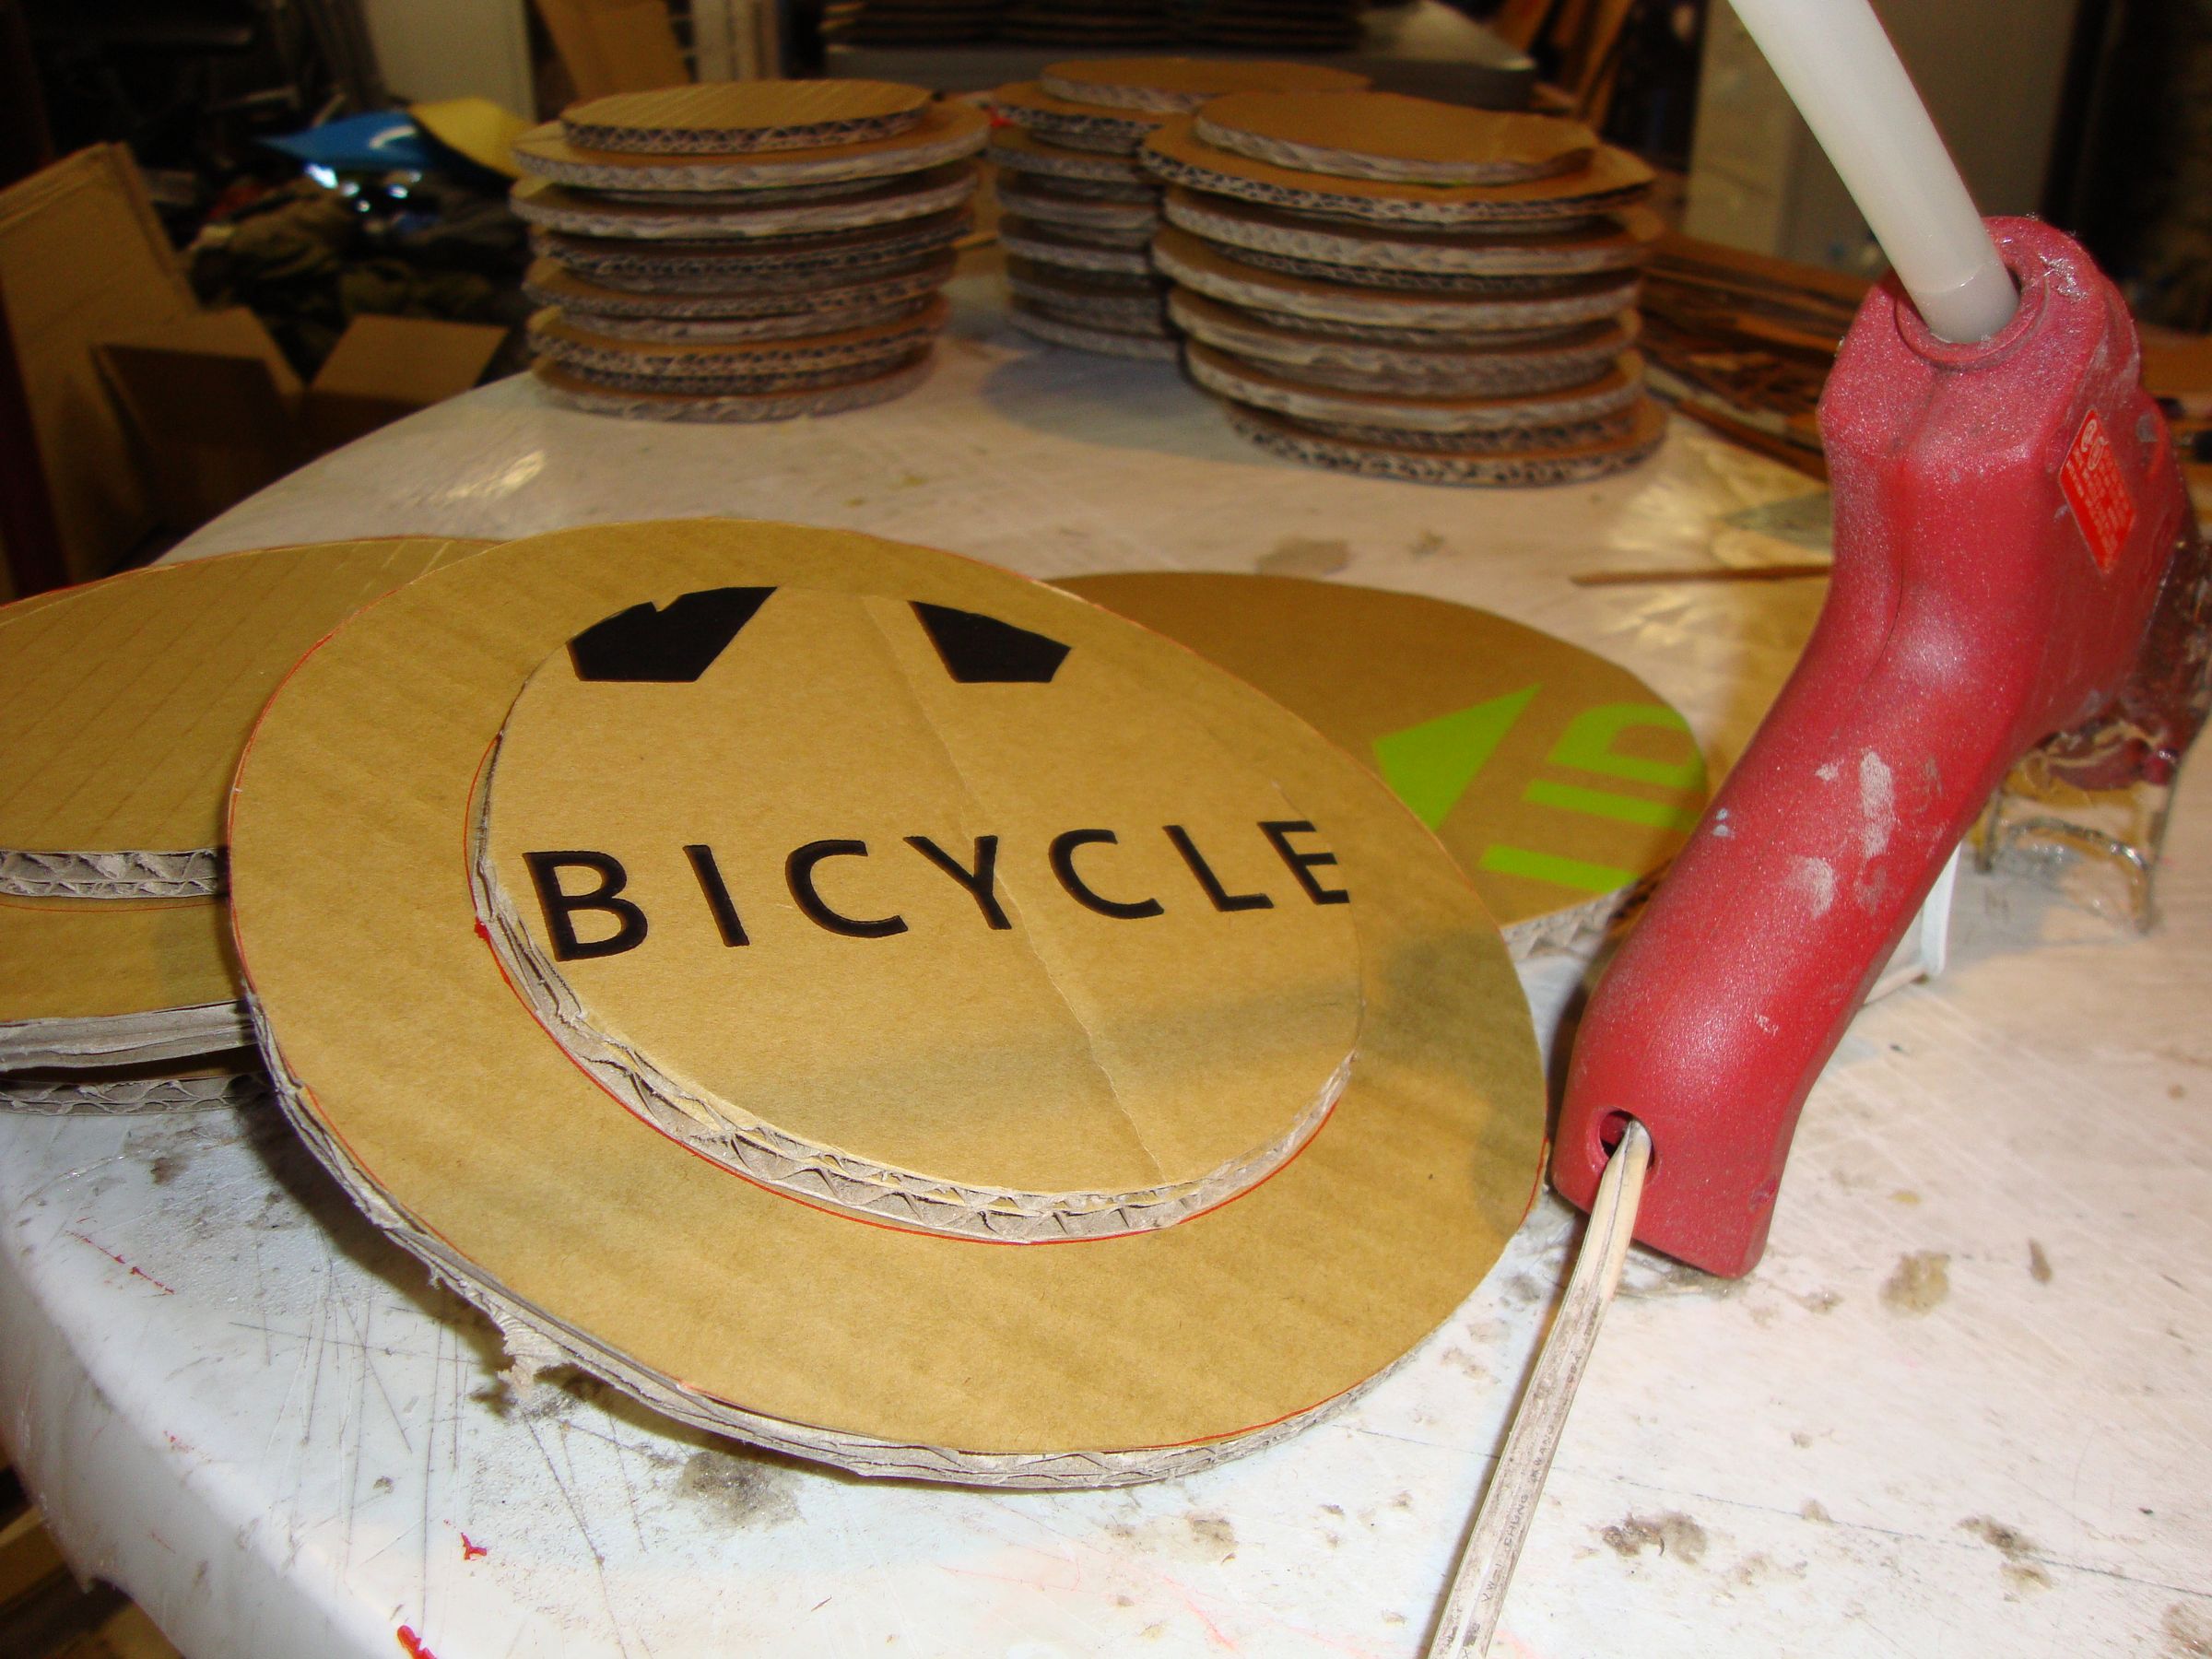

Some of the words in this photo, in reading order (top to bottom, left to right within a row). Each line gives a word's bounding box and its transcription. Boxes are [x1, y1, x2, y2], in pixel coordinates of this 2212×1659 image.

[525, 820, 1350, 961] BICYCLE
[1503, 1493, 1529, 1547] CHUNG
[1530, 1424, 1555, 1484] KWANG
